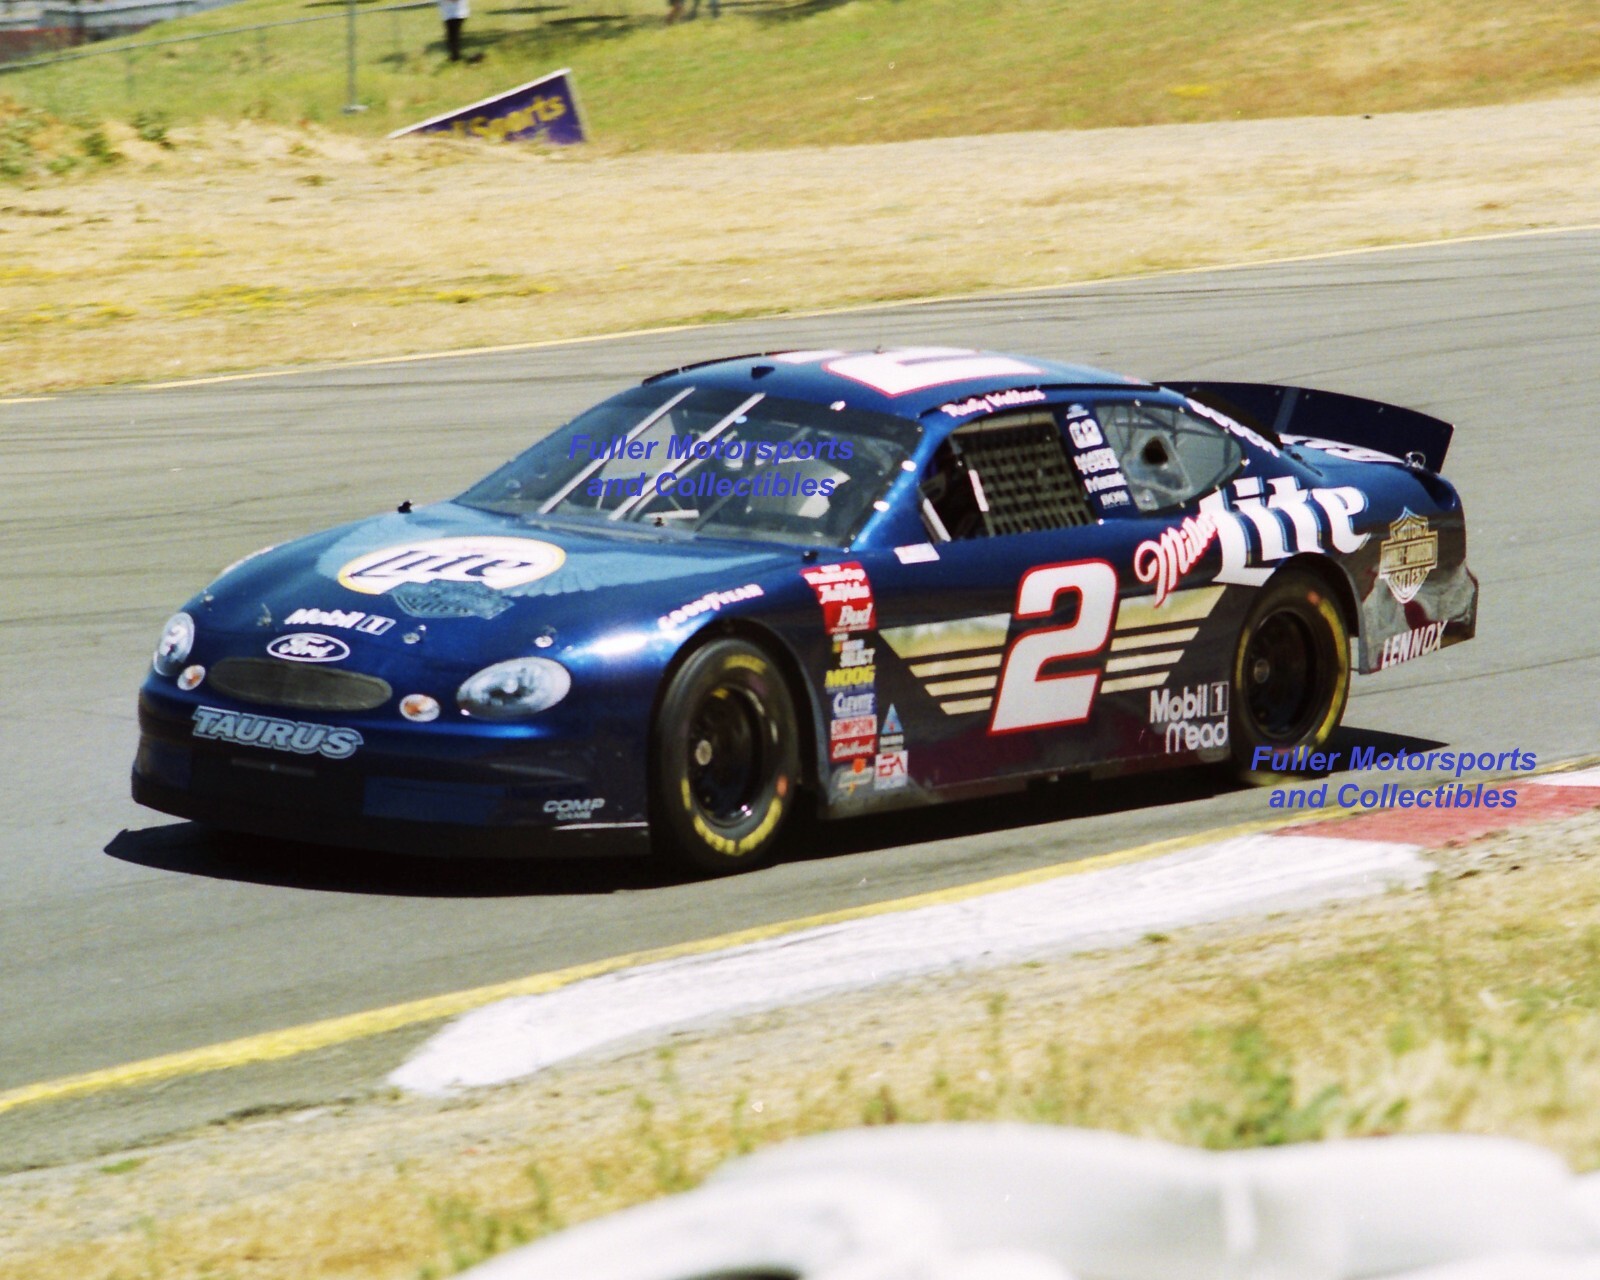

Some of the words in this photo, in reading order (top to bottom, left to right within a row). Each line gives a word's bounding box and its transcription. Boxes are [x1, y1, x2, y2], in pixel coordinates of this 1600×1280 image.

[1199, 475, 1371, 587] Lite
[284, 608, 366, 629] Mobil
[837, 602, 873, 627] Bud
[278, 637, 335, 657] Ford
[987, 557, 1119, 736] 2
[1381, 619, 1449, 670] LENNOX
[824, 664, 876, 688] MOOG
[1150, 684, 1207, 723] Mobil
[191, 705, 364, 759] TAURUS
[543, 798, 605, 813] COMP
